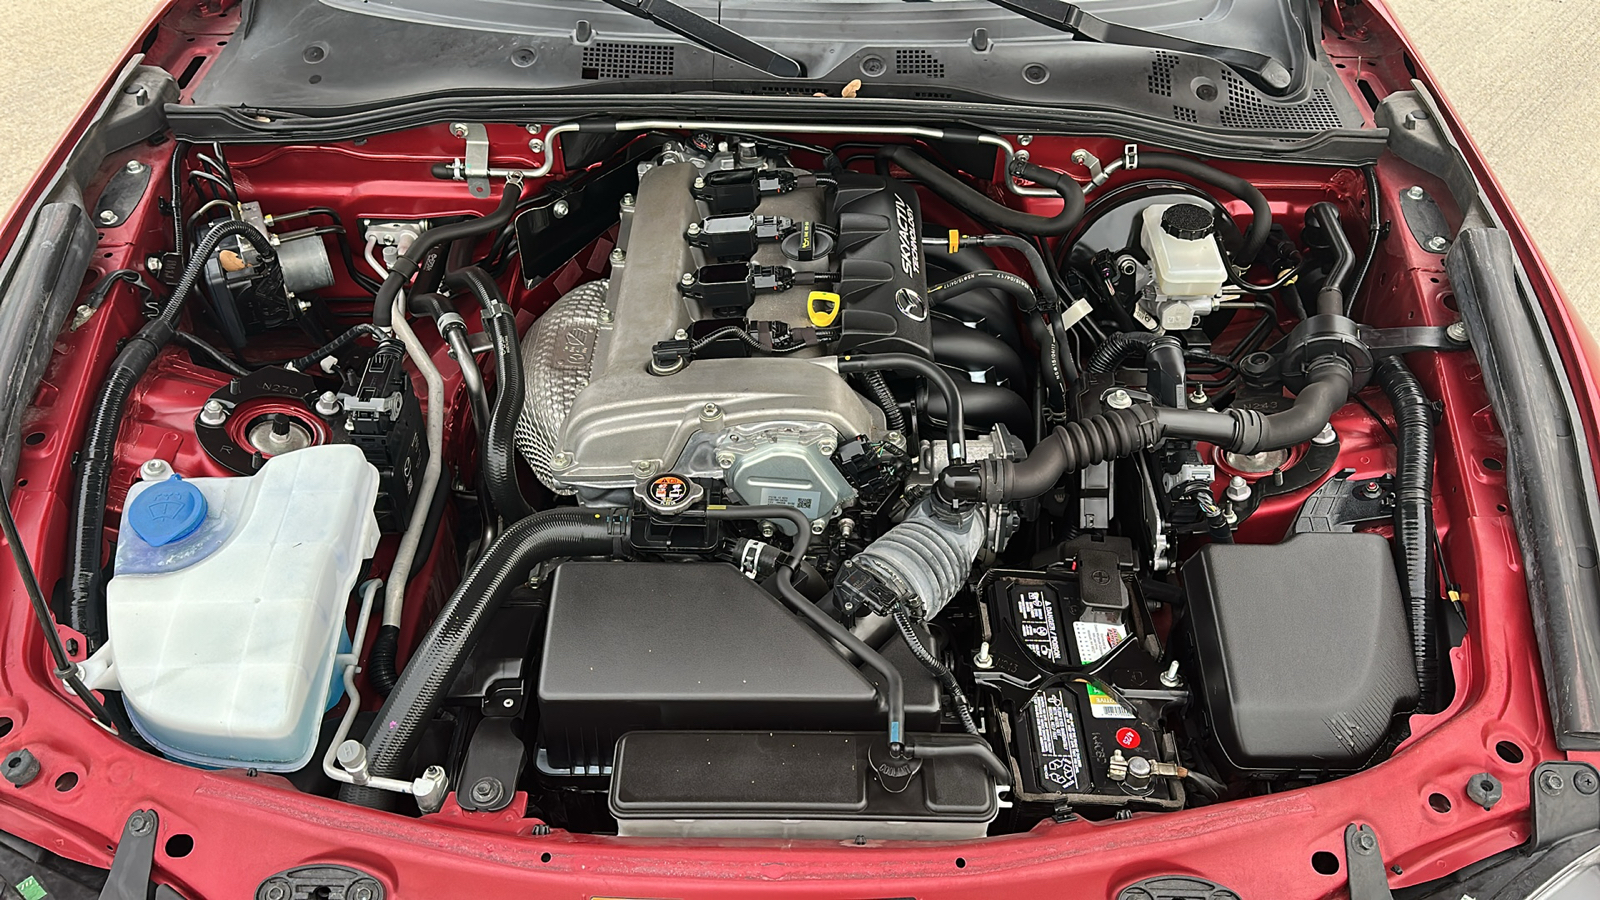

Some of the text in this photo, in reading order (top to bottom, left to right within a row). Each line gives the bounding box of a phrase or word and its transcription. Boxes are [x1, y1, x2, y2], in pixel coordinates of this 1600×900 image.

[894, 193, 913, 279] SKYACTIV
[906, 204, 919, 274] TECHNOLOGY
[262, 382, 298, 394] N270
[220, 445, 233, 454] R
[1046, 606, 1056, 631] DANGER
[1051, 636, 1061, 659] POISON
[343, 745, 353, 757] H
[879, 763, 911, 777] COOLANT
